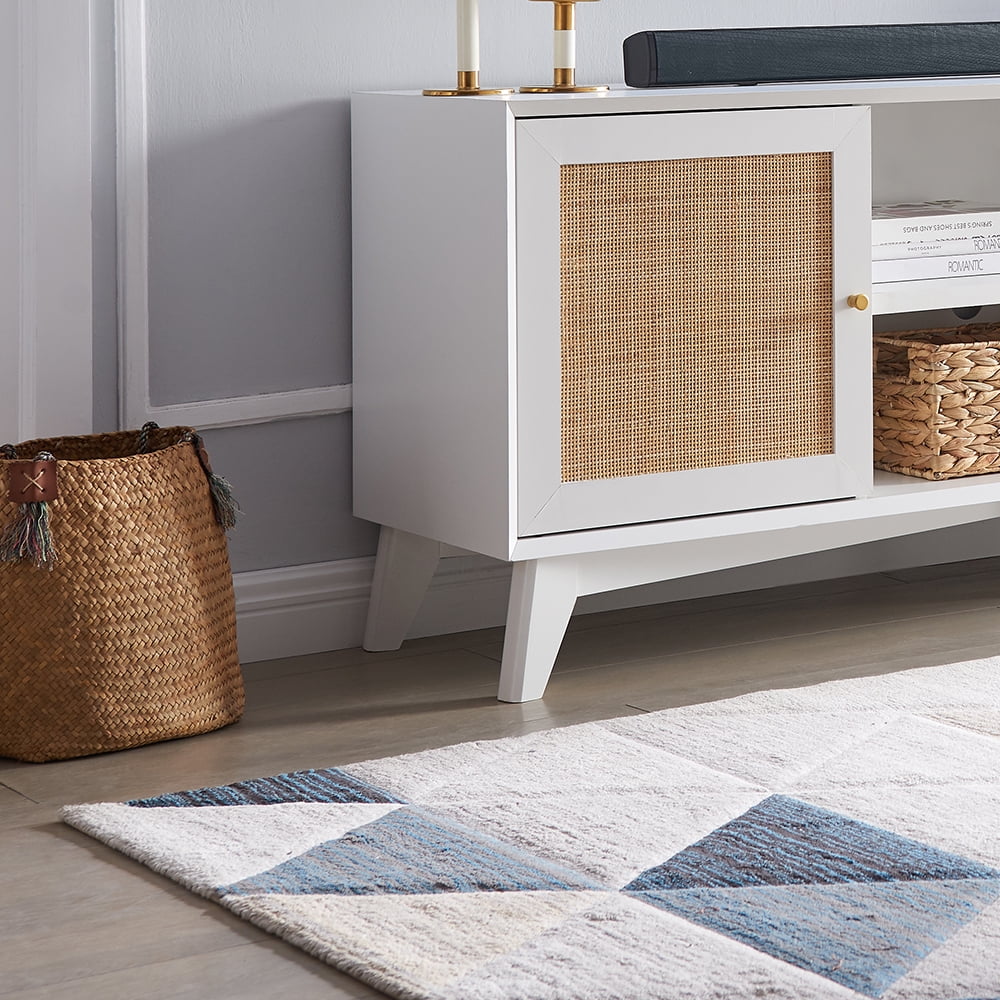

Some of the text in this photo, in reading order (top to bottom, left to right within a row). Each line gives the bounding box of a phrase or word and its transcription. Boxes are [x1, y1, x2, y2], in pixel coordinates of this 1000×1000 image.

[931, 223, 952, 231] SHOES
[952, 222, 967, 230] BEST
[948, 259, 984, 272] ROMANTIC
